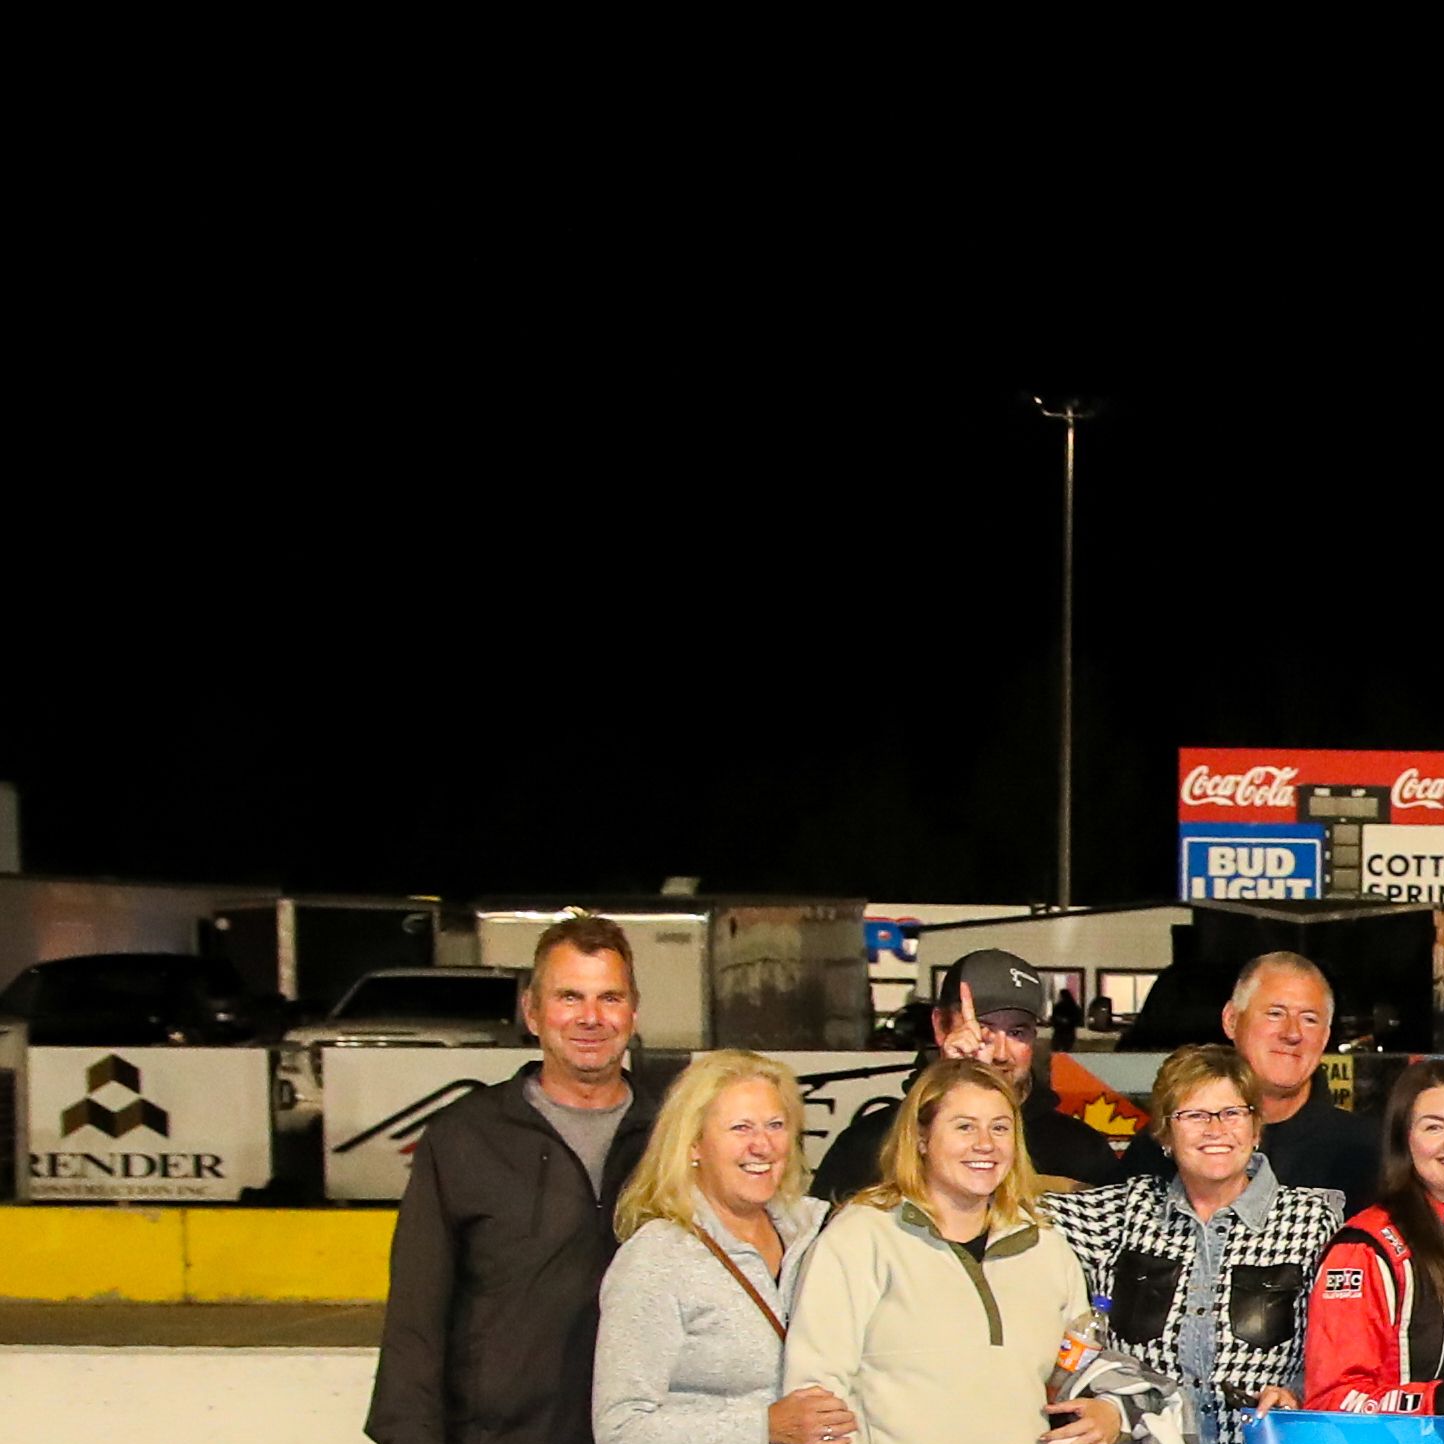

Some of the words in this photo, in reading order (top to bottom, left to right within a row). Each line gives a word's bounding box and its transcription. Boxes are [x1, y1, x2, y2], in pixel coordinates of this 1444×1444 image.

[1181, 765, 1299, 806] Coca-Cola
[1208, 846, 1295, 878] BUD
[1191, 877, 1312, 900] LIGHT
[1326, 1272, 1363, 1289] EPIC
